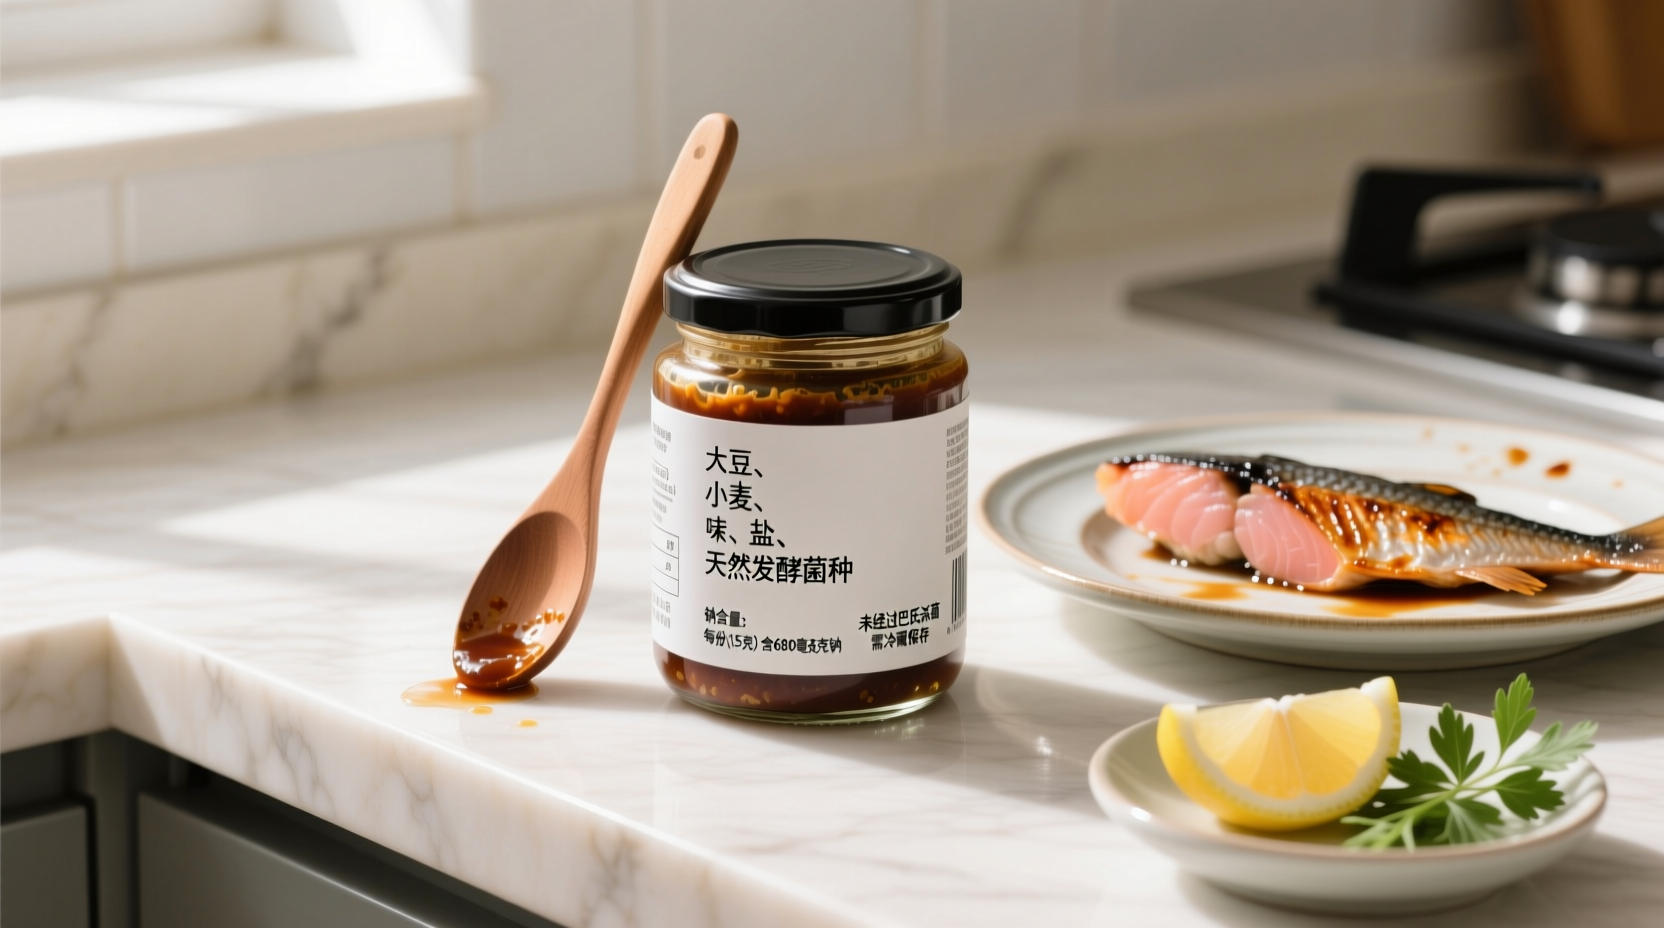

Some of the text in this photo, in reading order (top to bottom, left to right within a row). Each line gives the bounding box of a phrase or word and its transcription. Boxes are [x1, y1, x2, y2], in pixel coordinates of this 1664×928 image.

[705, 445, 763, 478] 大豆、
[705, 480, 763, 512] 小麦、
[705, 550, 853, 584] 天然发酵菌种
